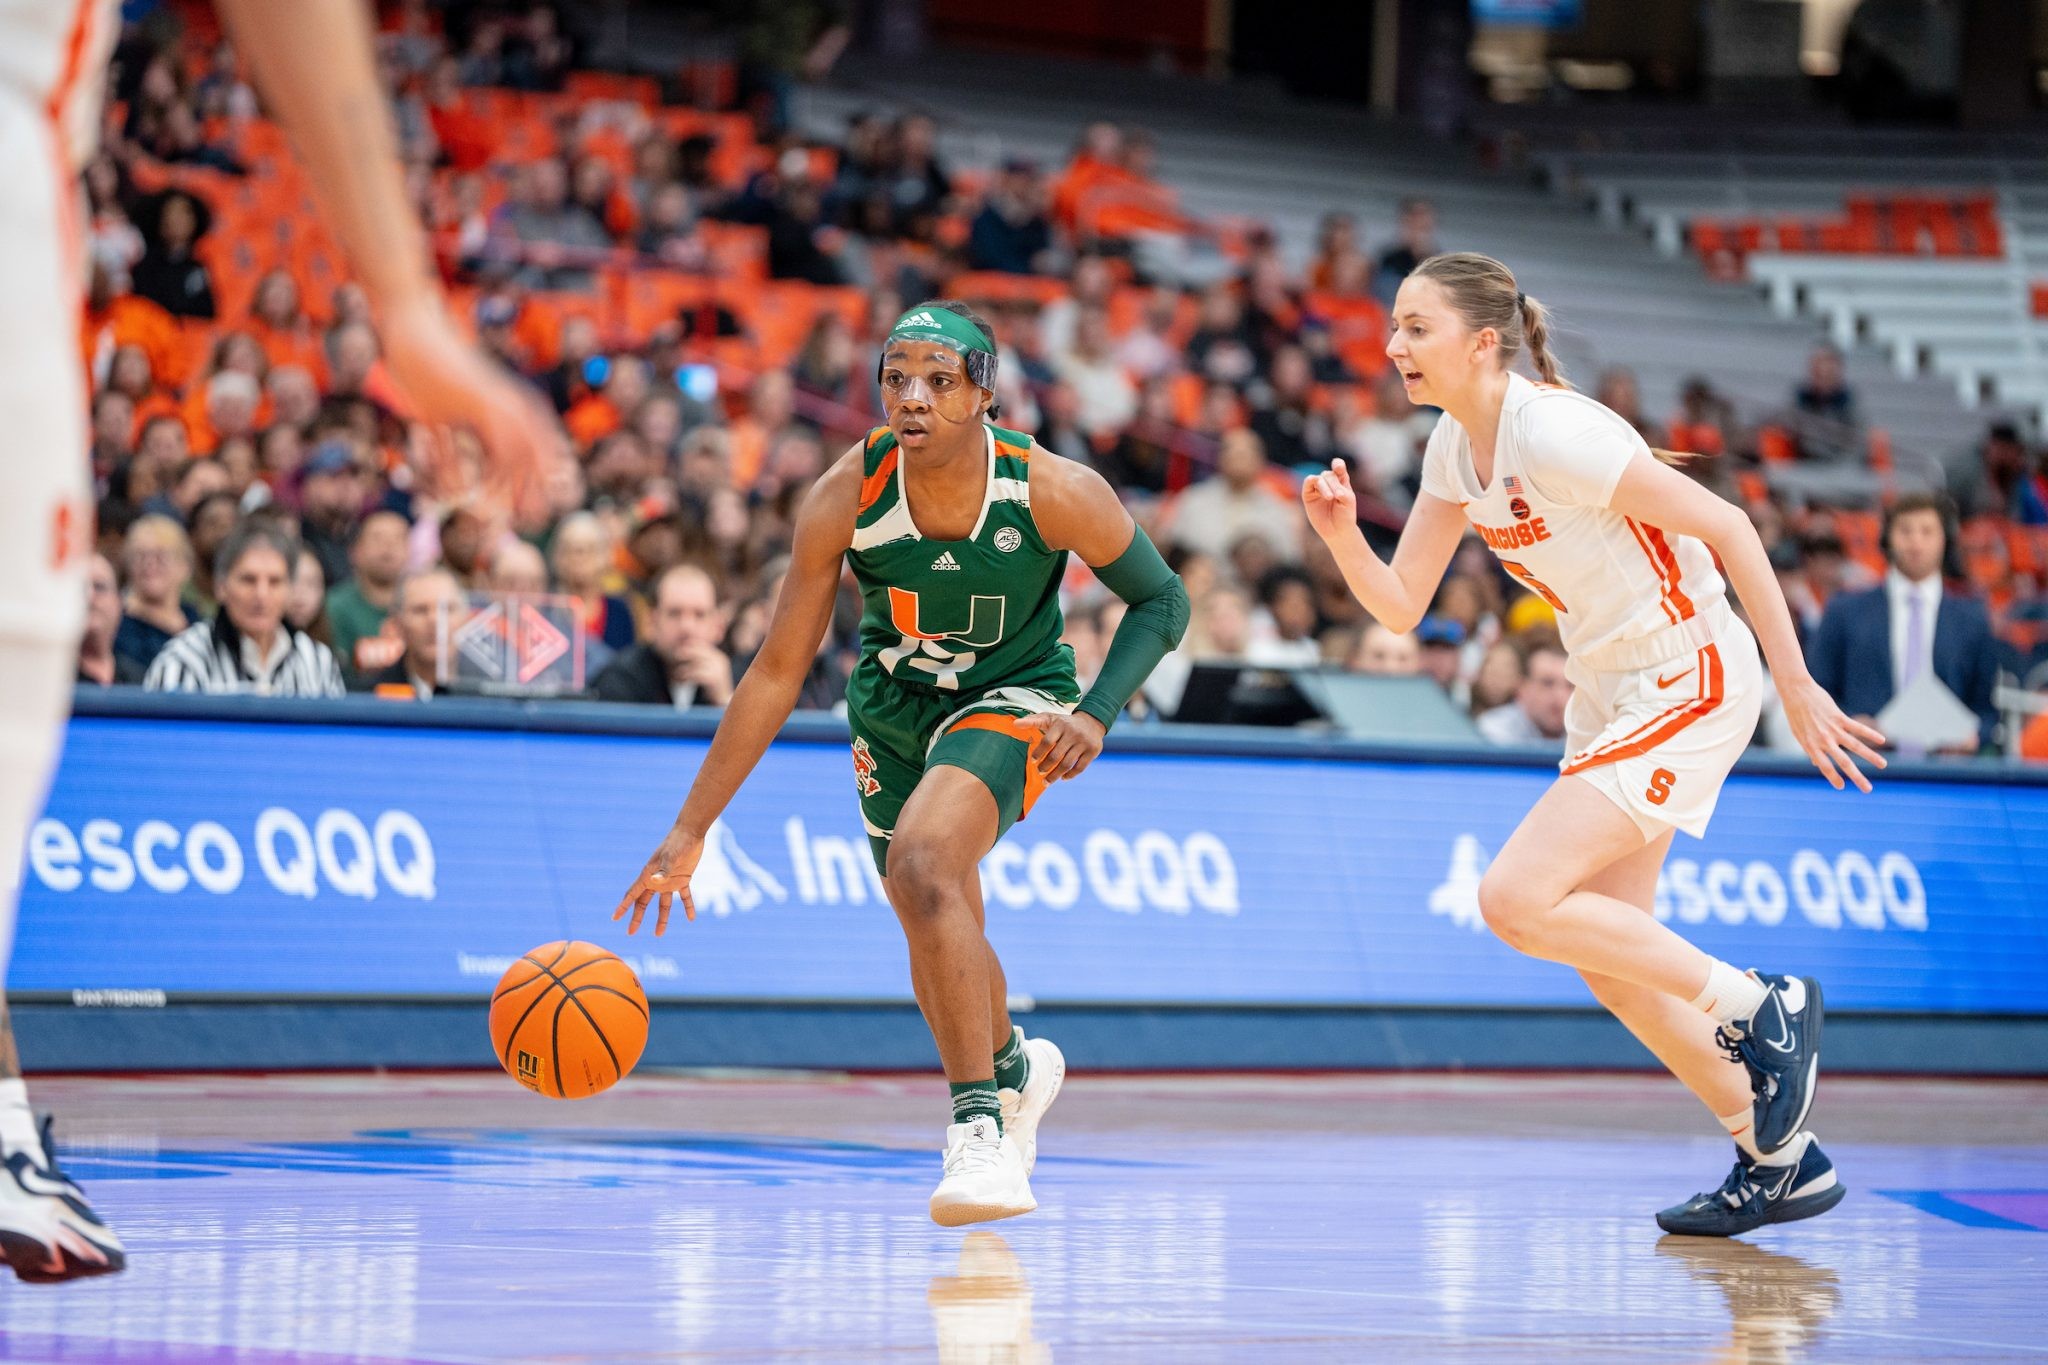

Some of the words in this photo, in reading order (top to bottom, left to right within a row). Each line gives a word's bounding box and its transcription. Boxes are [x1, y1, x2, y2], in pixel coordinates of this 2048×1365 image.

[895, 319, 942, 330] adidas
[998, 534, 1018, 542] ACC
[931, 563, 961, 571] adidas
[888, 586, 1006, 648] U
[1646, 767, 1676, 805] S
[29, 817, 245, 893] esco
[255, 806, 437, 901] QQQ
[1083, 828, 1241, 916] QQQ
[1790, 848, 1929, 932] QQQ
